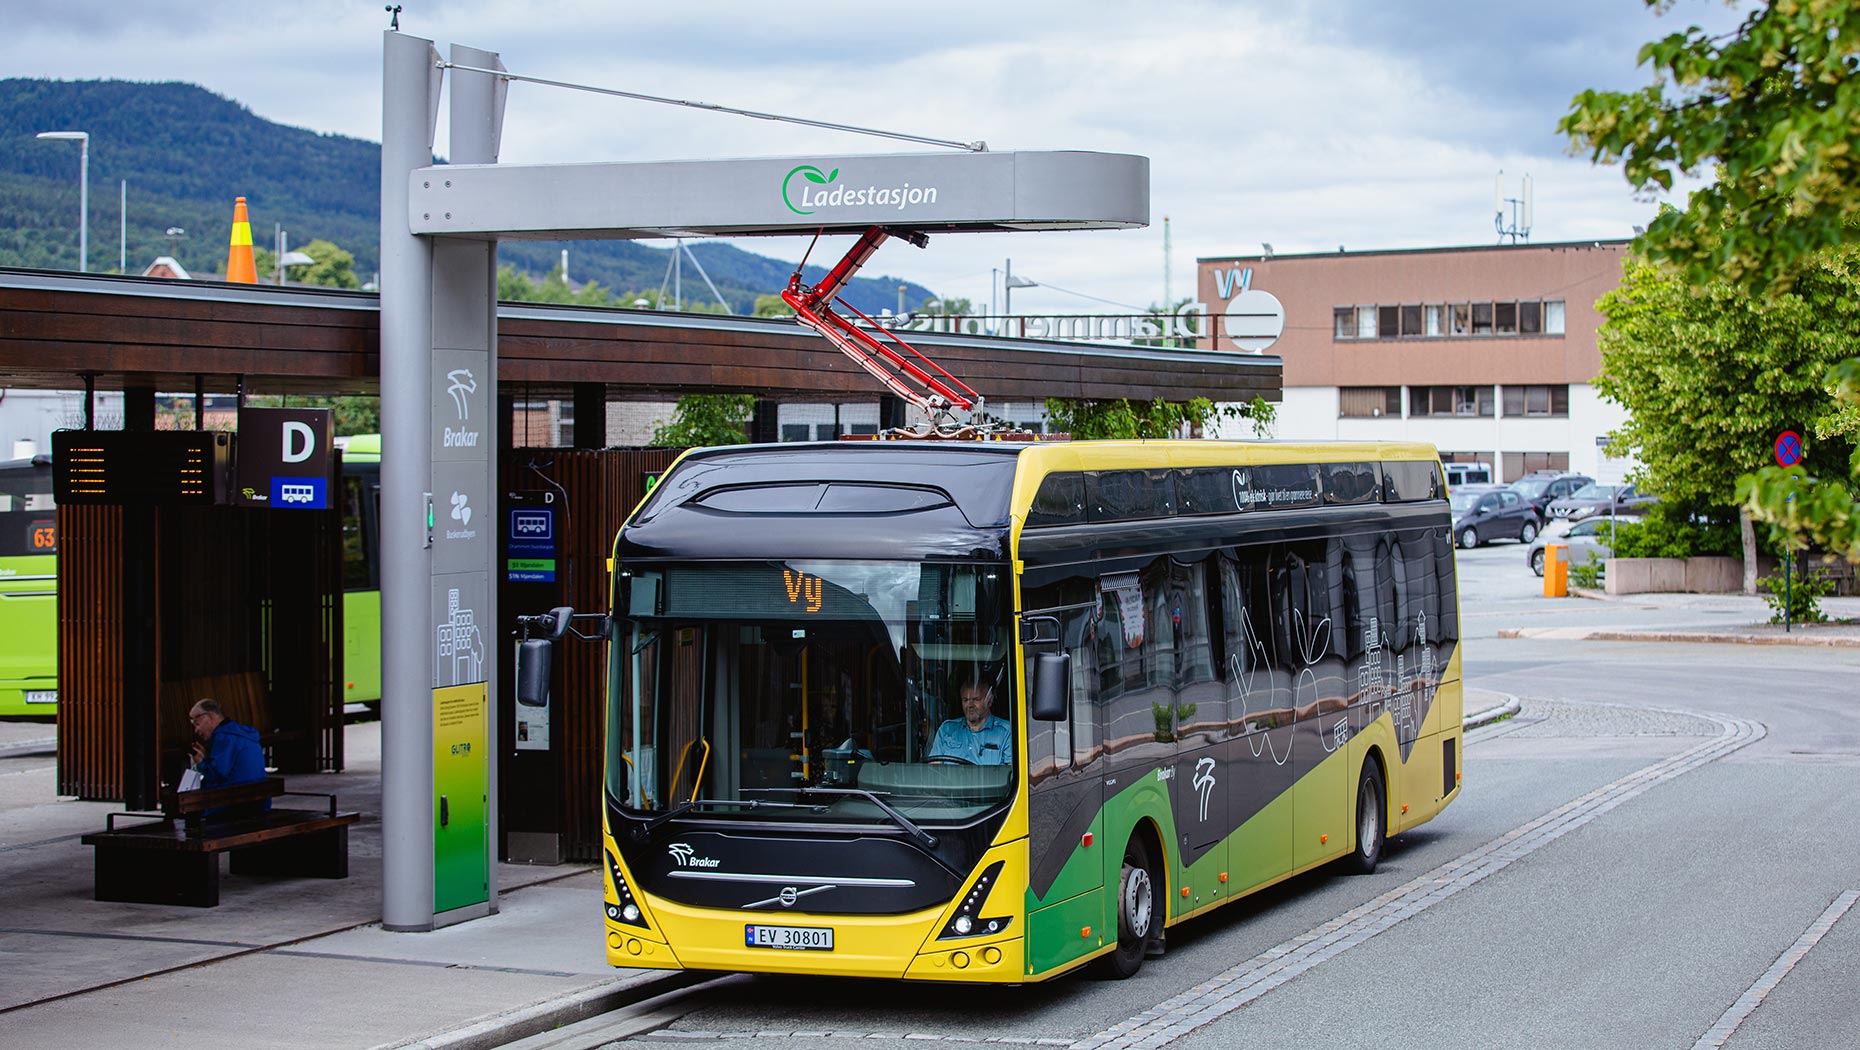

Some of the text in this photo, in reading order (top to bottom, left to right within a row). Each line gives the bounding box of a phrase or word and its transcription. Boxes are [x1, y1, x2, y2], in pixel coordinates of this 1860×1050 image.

[801, 183, 938, 210] Ladestasjon
[282, 421, 316, 463] D
[443, 426, 479, 447] Brakar
[545, 492, 554, 503] D
[34, 527, 55, 548] 63
[783, 569, 822, 612] Vy
[689, 856, 721, 868] Brakar
[760, 929, 777, 943] EV
[784, 930, 828, 946] 30801
